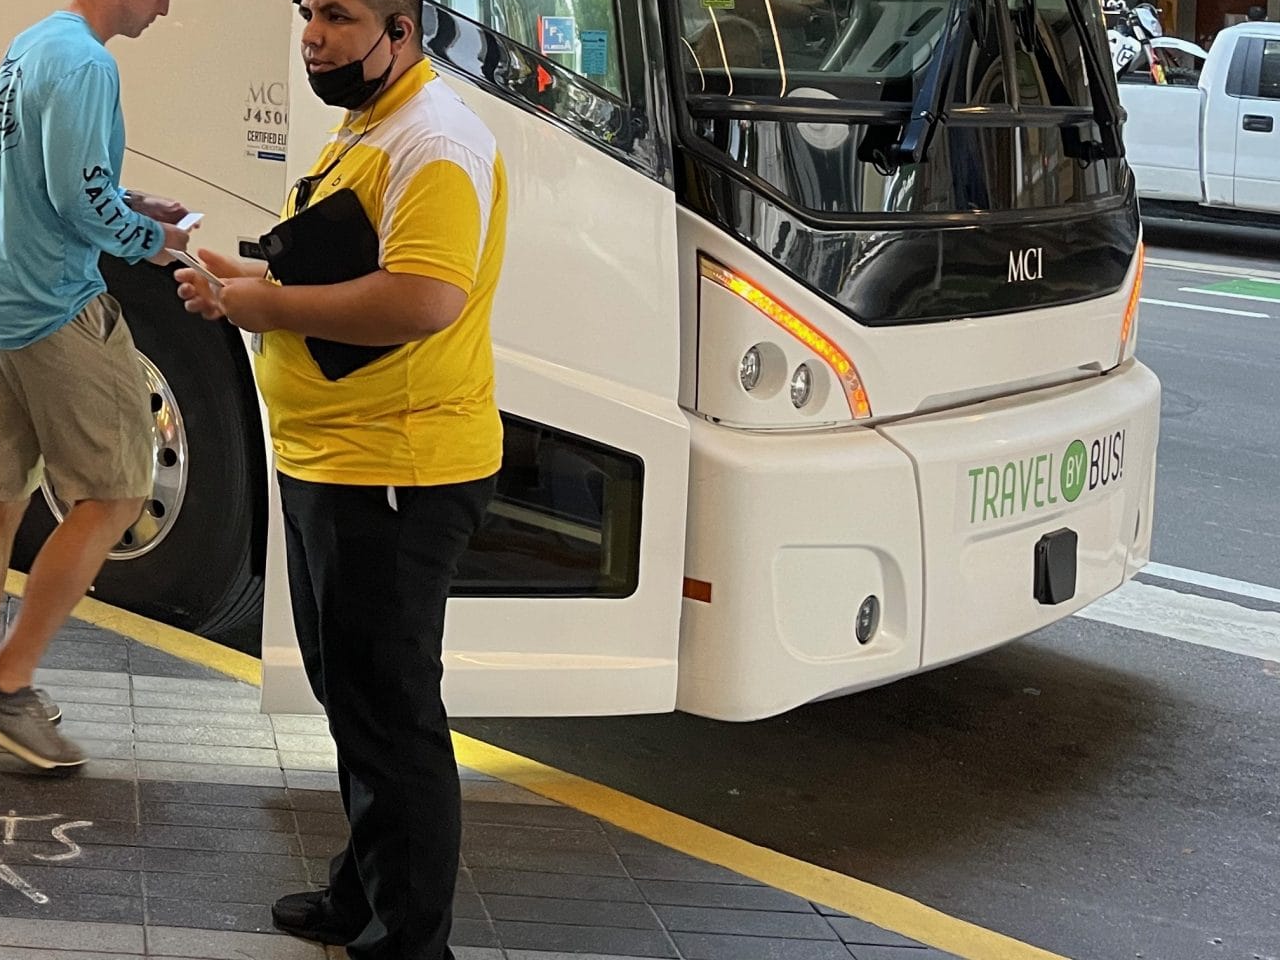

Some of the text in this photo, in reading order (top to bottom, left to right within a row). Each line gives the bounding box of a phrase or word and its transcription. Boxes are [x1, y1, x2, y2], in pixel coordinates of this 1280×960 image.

[247, 130, 276, 144] CERTIFIED
[83, 165, 122, 226] SALT
[1007, 247, 1044, 283] MCI
[968, 429, 1125, 524] TRAVEL BY BUS!
